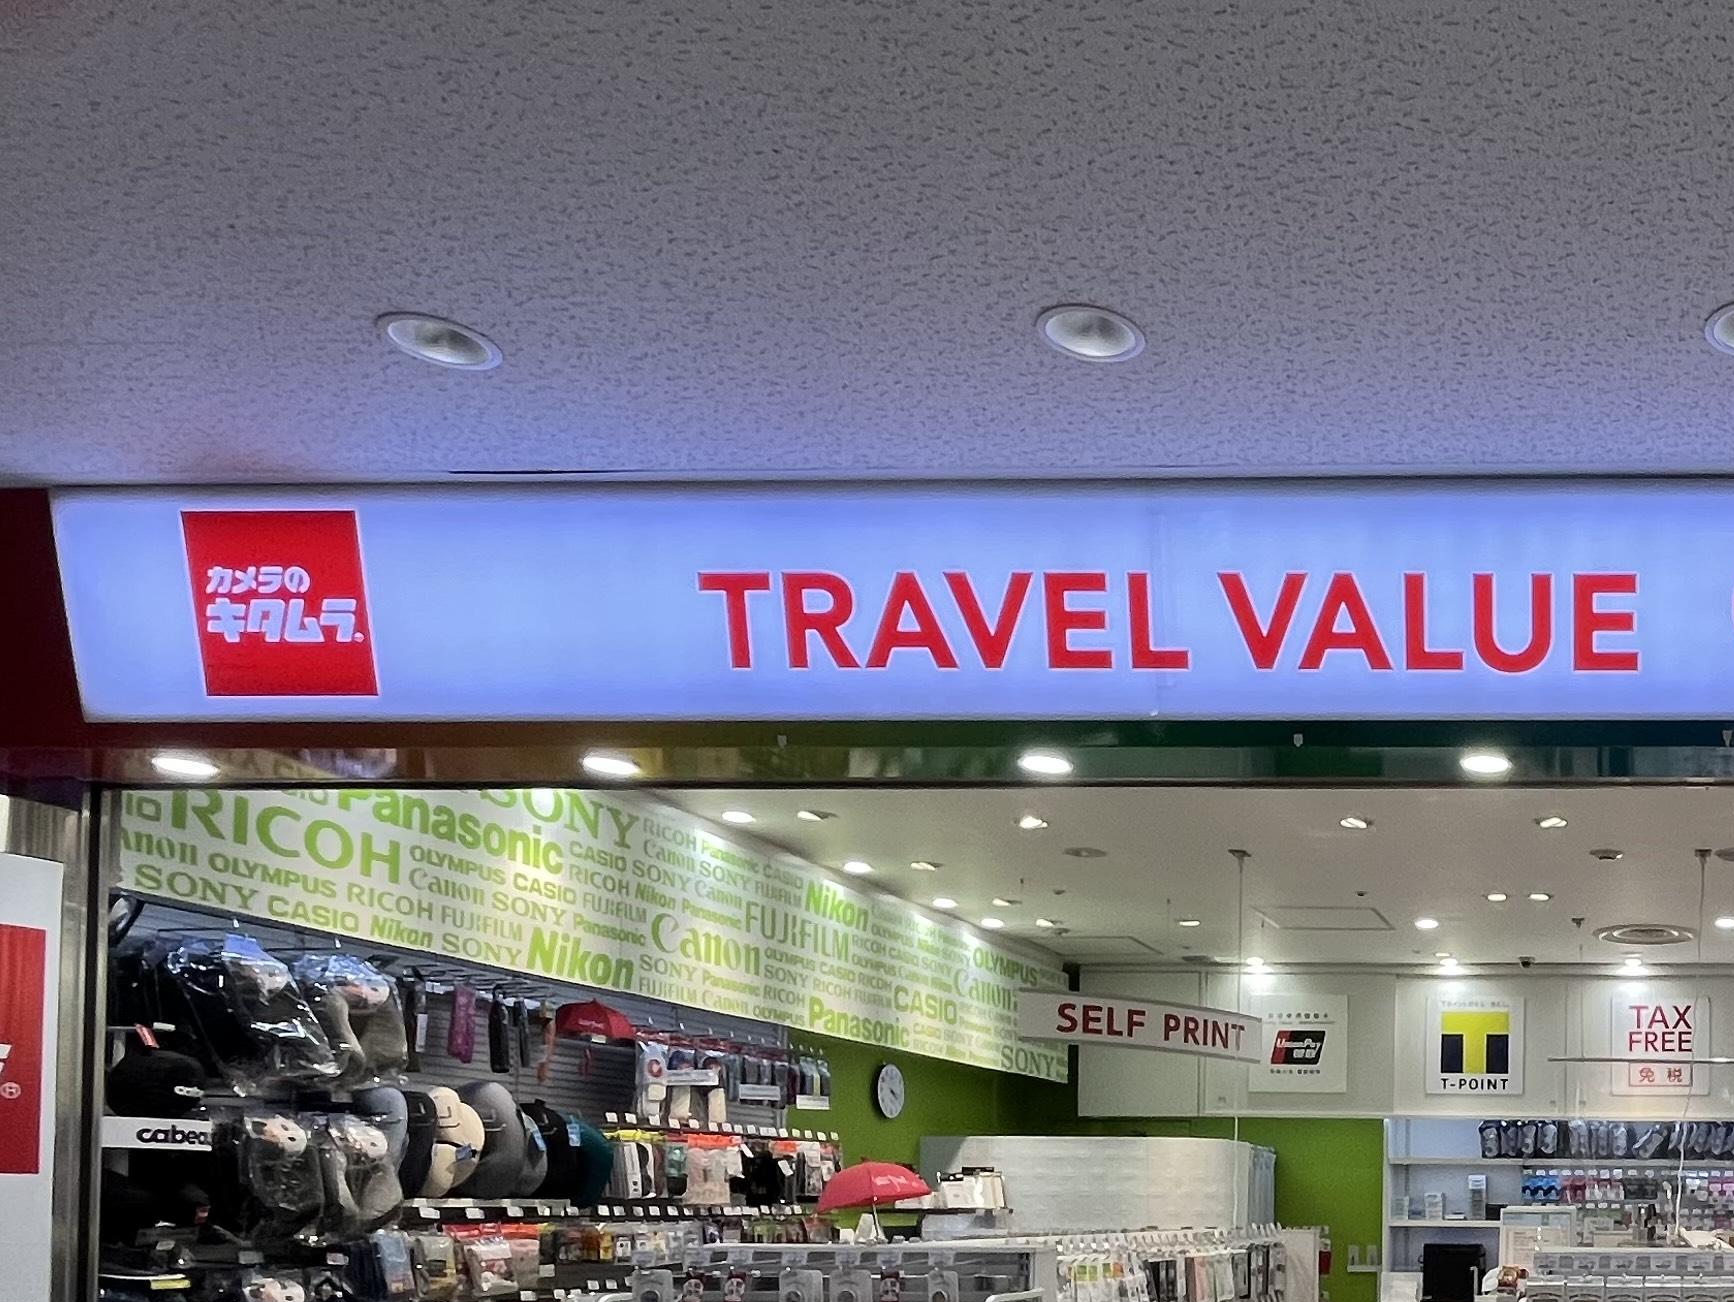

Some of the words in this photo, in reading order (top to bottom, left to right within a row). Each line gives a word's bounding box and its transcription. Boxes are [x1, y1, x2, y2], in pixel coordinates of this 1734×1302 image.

[205, 566, 311, 594] カメラの
[205, 597, 358, 643] キタムラ
[701, 573, 1189, 669] TRAVEL
[1220, 573, 1639, 673] VALUE
[171, 789, 400, 885] RICOH
[643, 817, 697, 852] RICOH
[763, 862, 804, 890] CASIO
[121, 827, 197, 866] anon
[208, 853, 337, 898] OLYMPUS
[347, 883, 433, 921] RICOH
[441, 904, 523, 941] FUJIFILM
[409, 844, 506, 885] OLYMPUS
[513, 872, 577, 905] CASIO
[583, 893, 647, 923] FUJIFILM
[569, 841, 627, 872] CASIO
[632, 860, 692, 892] SONY
[694, 879, 743, 911] Canon
[569, 864, 629, 897] RICOH
[635, 881, 676, 911] Nikon
[643, 839, 695, 873] Canon
[700, 860, 750, 893] SONY
[135, 864, 259, 910] SONY
[267, 895, 360, 933] CASIO
[370, 914, 433, 949] Nikon
[441, 932, 523, 967] SONY
[409, 867, 485, 906] Canon
[492, 891, 567, 927] SONY
[572, 912, 647, 947] Panasonic
[744, 899, 849, 962] FUJIFILM
[805, 879, 870, 933] Nikon
[526, 927, 634, 990] Nikon
[639, 953, 698, 982] SONY
[651, 912, 761, 977] Canon
[764, 947, 816, 973] OLYMPUS
[819, 960, 856, 982] CASIO
[973, 947, 1038, 987] OLYMPUS
[639, 976, 697, 1004] FUJIFILM
[702, 990, 749, 1014] Canon
[753, 1005, 805, 1027] OLYMPUS
[763, 984, 806, 1009] RICOH
[764, 964, 809, 989] SONY
[813, 977, 849, 999] RICOH
[893, 985, 958, 1025] CASIO
[953, 967, 1013, 1011] Canon
[809, 996, 910, 1048] Panasonic
[1056, 1002, 1146, 1038] SELF
[1163, 1013, 1245, 1051] PRINT
[1628, 1031, 1693, 1052] FREE
[1629, 1004, 1693, 1030] TAX
[1001, 1045, 1057, 1077] SONY
[1440, 1077, 1509, 1091] T-POINT
[1639, 1067, 1684, 1083] 免税
